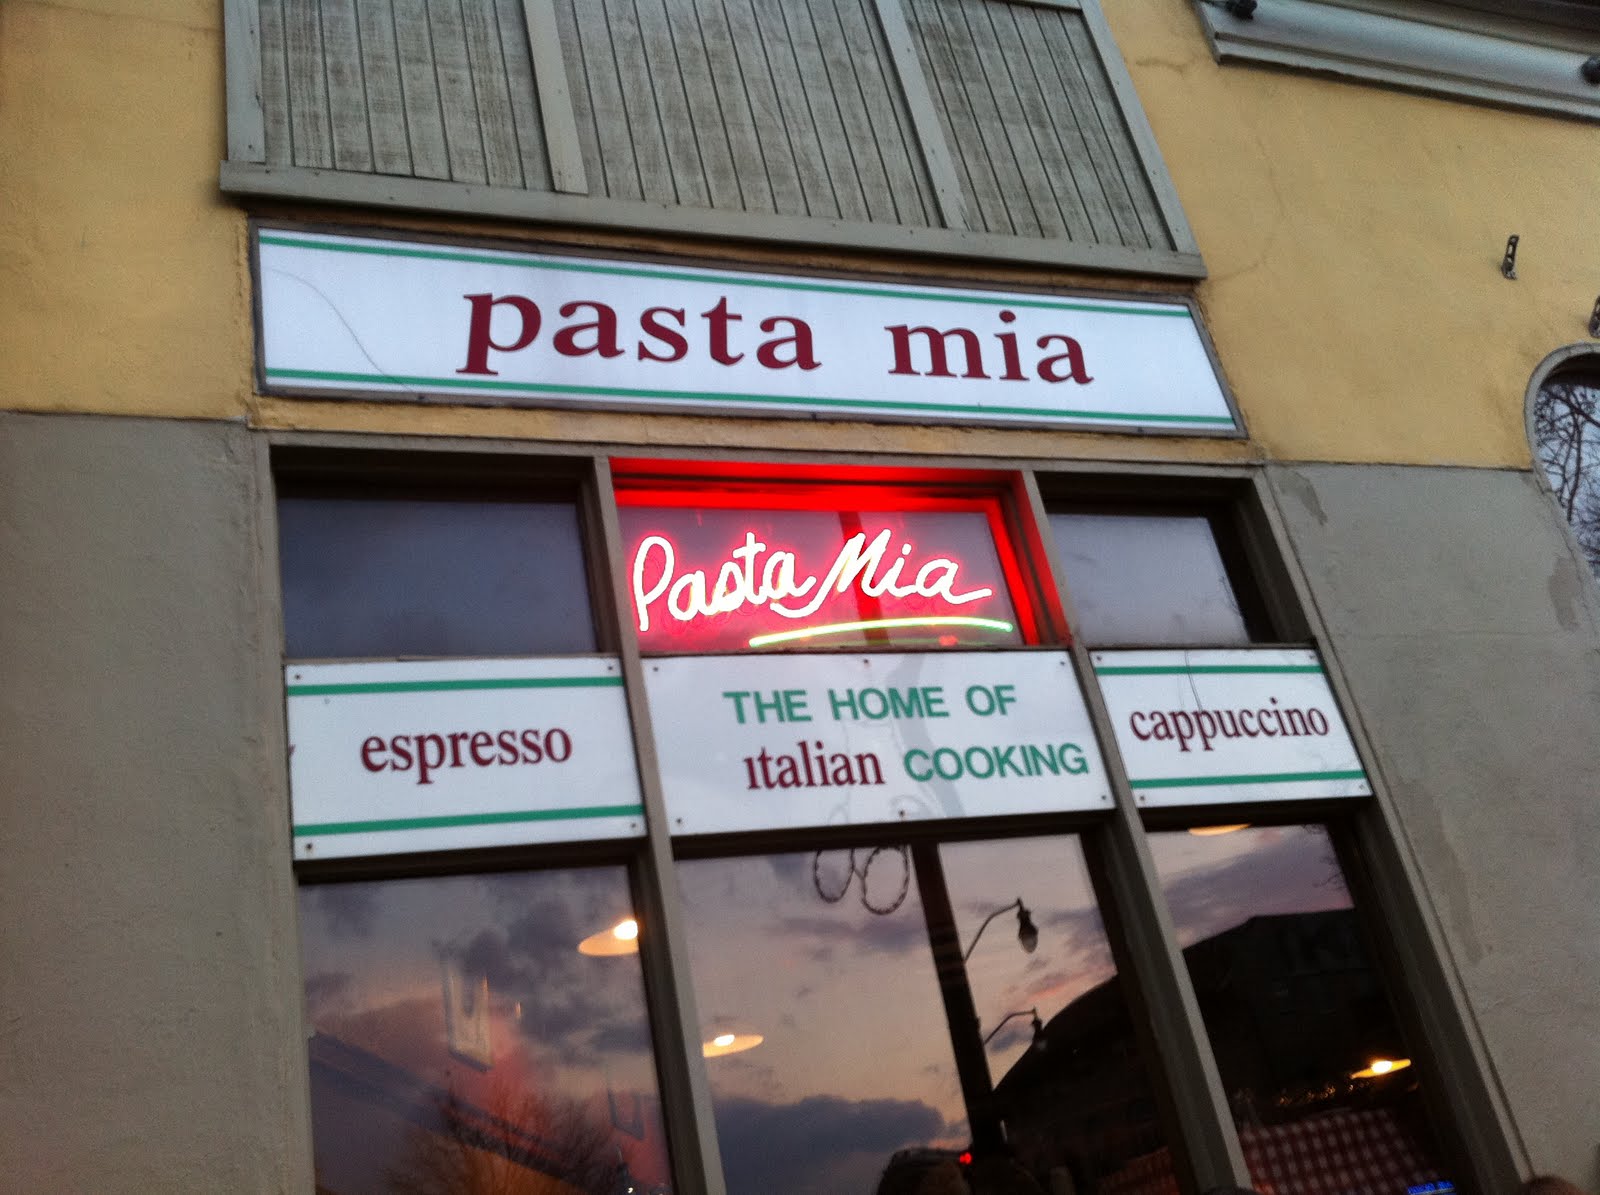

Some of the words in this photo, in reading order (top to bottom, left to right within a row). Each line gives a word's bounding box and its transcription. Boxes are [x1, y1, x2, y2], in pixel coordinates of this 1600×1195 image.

[456, 293, 822, 376] pasta
[886, 311, 1093, 385] mia
[632, 532, 817, 632] Pasta
[772, 528, 993, 619] Mia
[723, 689, 812, 724] THE
[829, 687, 949, 721] HOME
[965, 685, 1017, 716] OF
[1129, 697, 1329, 752] cappuccino
[361, 728, 573, 785] espresso
[744, 741, 886, 790] italian
[903, 743, 1089, 782] COOKING
